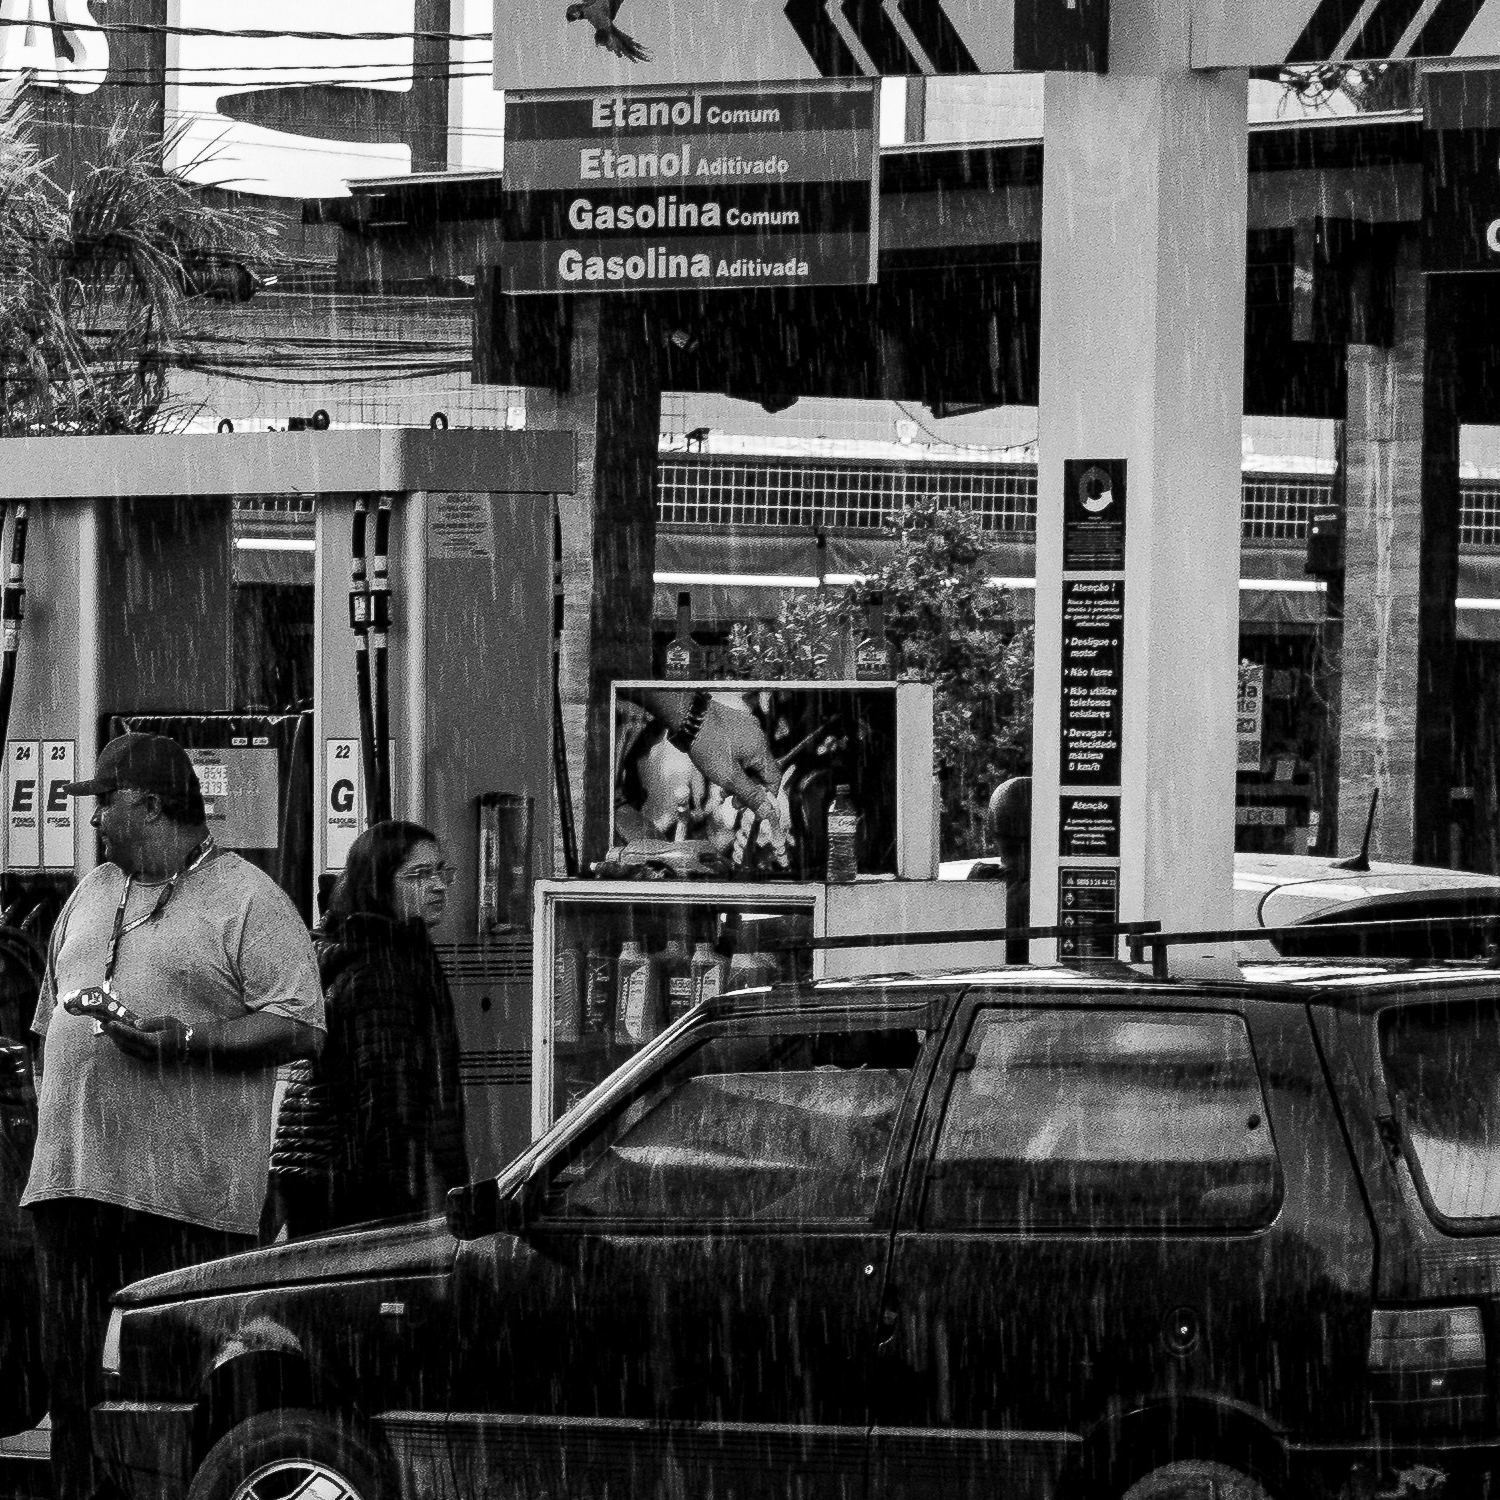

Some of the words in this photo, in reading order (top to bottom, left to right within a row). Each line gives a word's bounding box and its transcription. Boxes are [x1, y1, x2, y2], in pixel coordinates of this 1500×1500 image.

[591, 95, 701, 128] Etanol
[706, 106, 780, 124] Comum
[579, 144, 691, 180] Etanol
[695, 155, 789, 177] Aditivado
[568, 196, 721, 230] Gasolina
[726, 208, 800, 227] Comum
[558, 247, 710, 281] Gasolina
[716, 258, 810, 278] Aditivada
[15, 746, 32, 761] 24
[50, 746, 66, 761] 23
[334, 744, 351, 759] 22
[11, 779, 36, 812] E
[46, 779, 71, 812] E
[330, 778, 355, 813] G
[1071, 801, 1109, 814] Atenção
